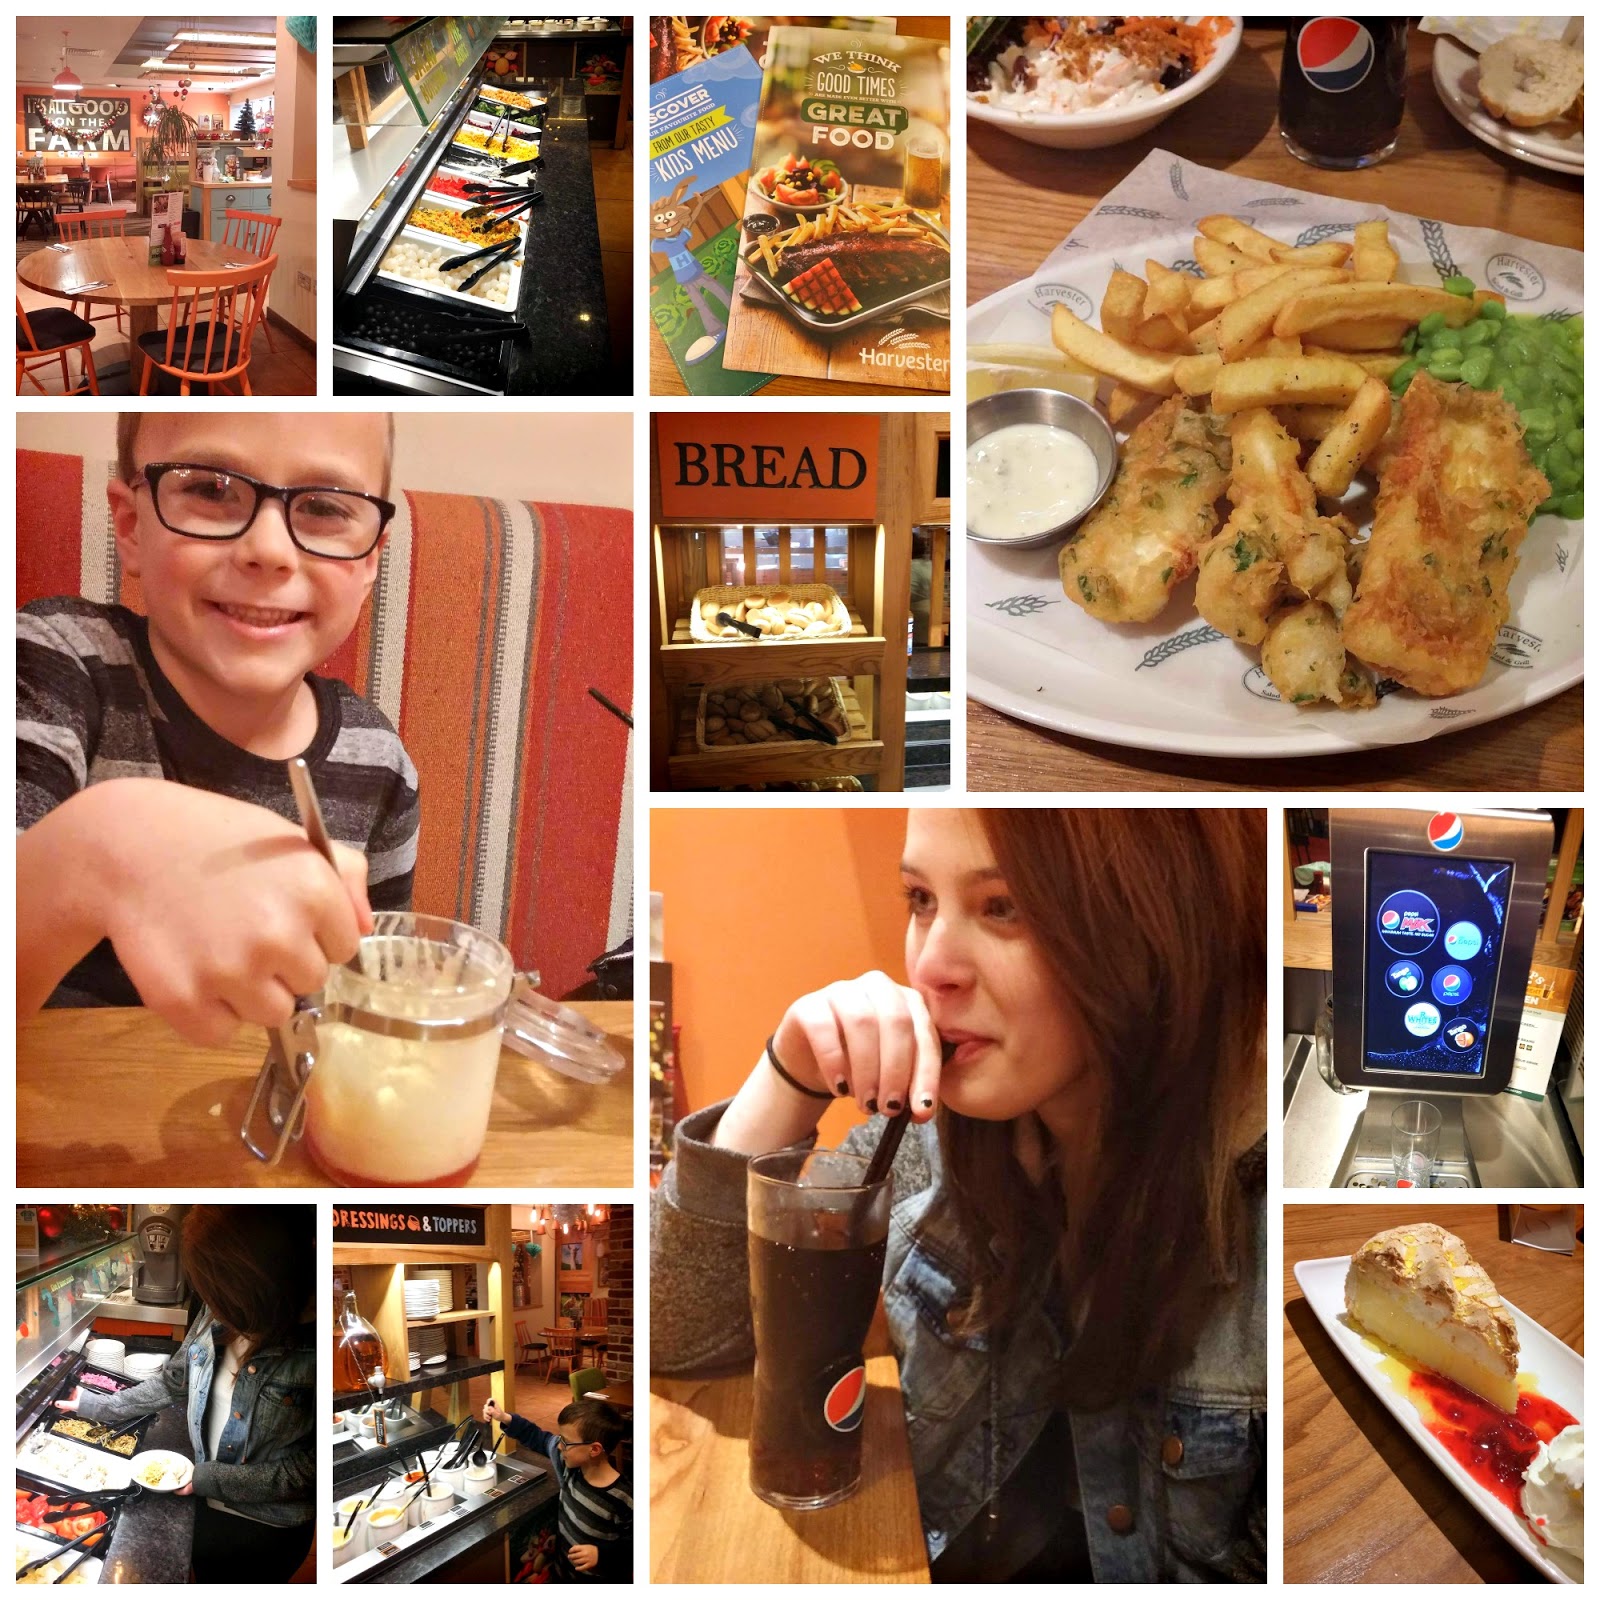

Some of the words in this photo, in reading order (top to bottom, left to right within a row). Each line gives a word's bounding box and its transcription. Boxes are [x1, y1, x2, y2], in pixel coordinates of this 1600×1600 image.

[812, 51, 842, 64] WE
[846, 51, 902, 73] THINK
[817, 72, 851, 93] GOOD
[856, 76, 896, 98] TIMES
[48, 99, 67, 114] ALL
[68, 99, 129, 116] GOOD
[660, 111, 698, 132] FAVOURITE
[698, 102, 715, 115] FOOD
[807, 102, 902, 127] GREAT
[54, 117, 75, 127] ON
[79, 118, 105, 127] THE
[652, 137, 675, 153] FROM
[674, 128, 692, 143] OUR
[690, 115, 716, 136] TASTY
[28, 128, 130, 151] FARM
[812, 125, 895, 150] FOOD
[654, 149, 693, 183] KIDS
[691, 126, 739, 164] MENU
[1497, 256, 1541, 285] Harvester
[1034, 287, 1087, 306] Harvester
[859, 347, 950, 373] Harvester
[673, 442, 867, 490] BREAD
[1400, 916, 1435, 933] MAX
[333, 1208, 405, 1231] DRESSINGS
[422, 1215, 432, 1232] &
[432, 1216, 477, 1234] TOPPERS
